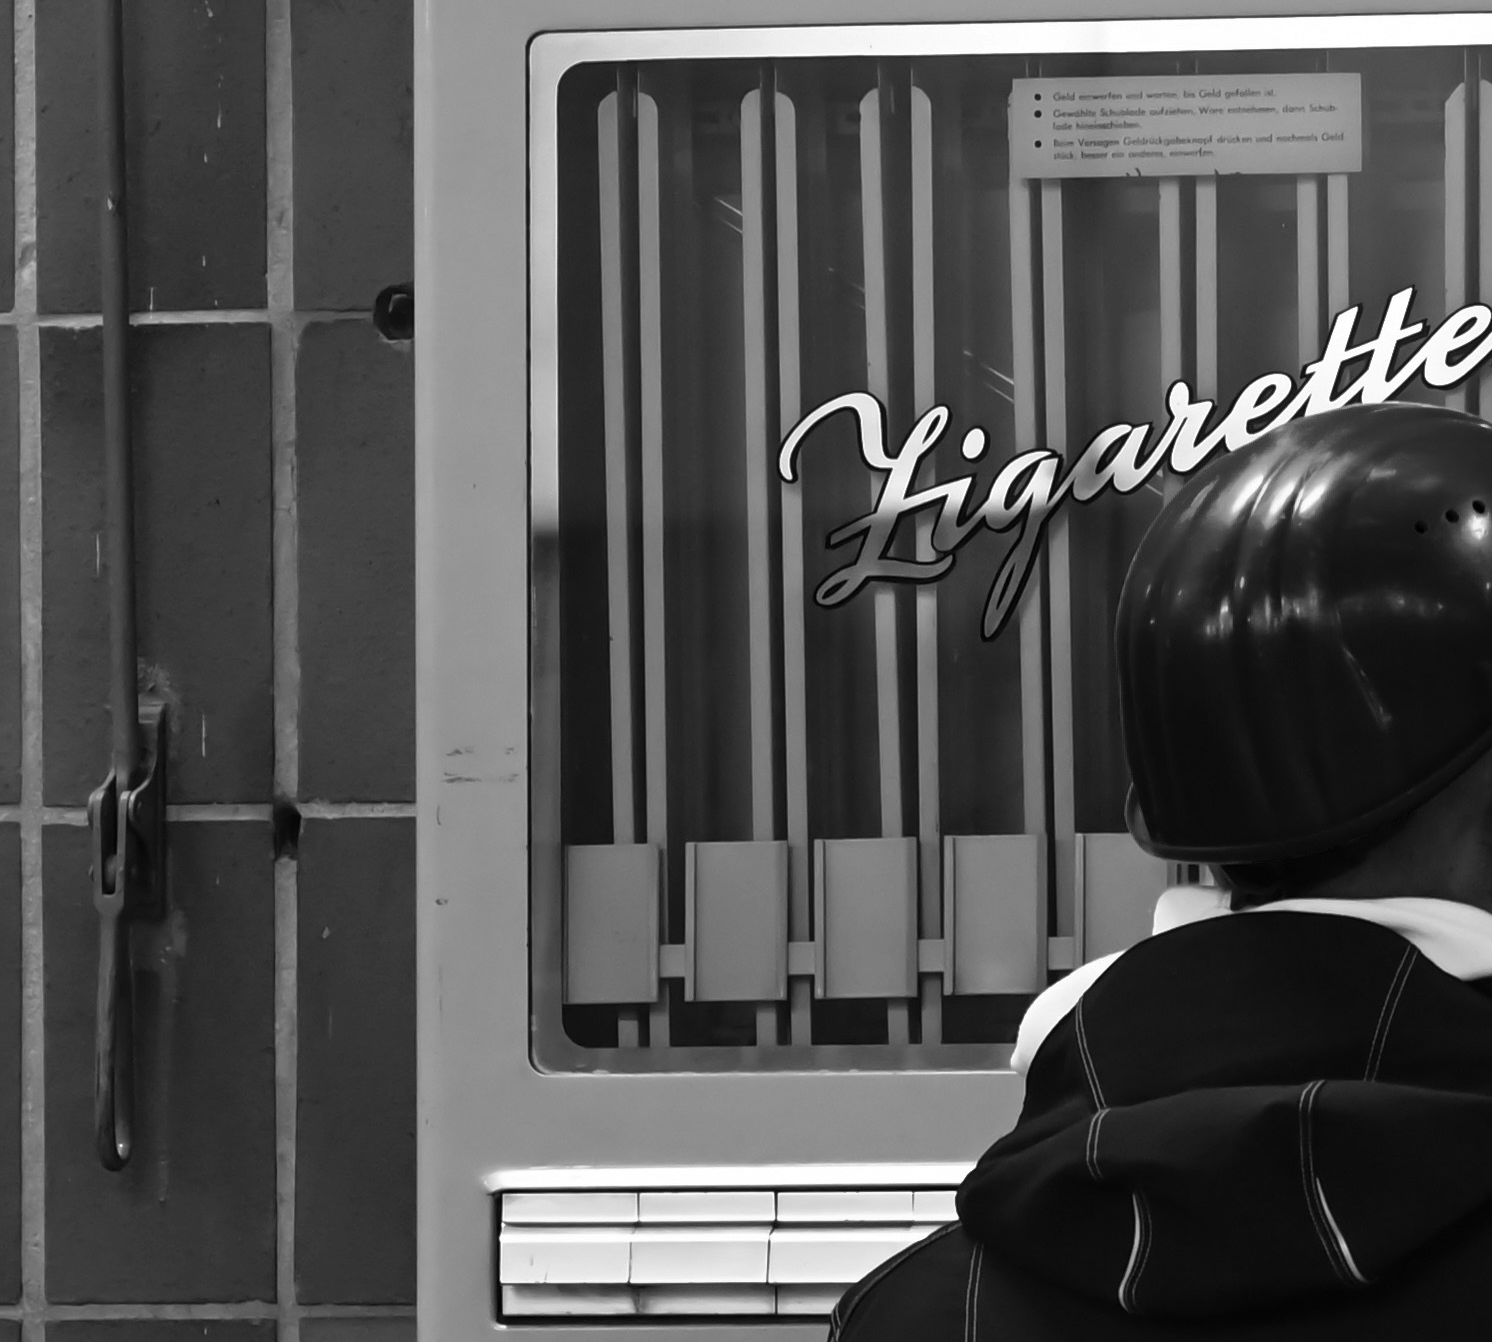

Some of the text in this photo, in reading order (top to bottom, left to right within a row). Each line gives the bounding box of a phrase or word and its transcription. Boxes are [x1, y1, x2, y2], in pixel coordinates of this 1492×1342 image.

[1053, 91, 1075, 101] Geld
[1126, 91, 1143, 99] und
[1199, 88, 1221, 98] Geld
[1256, 133, 1272, 143] und
